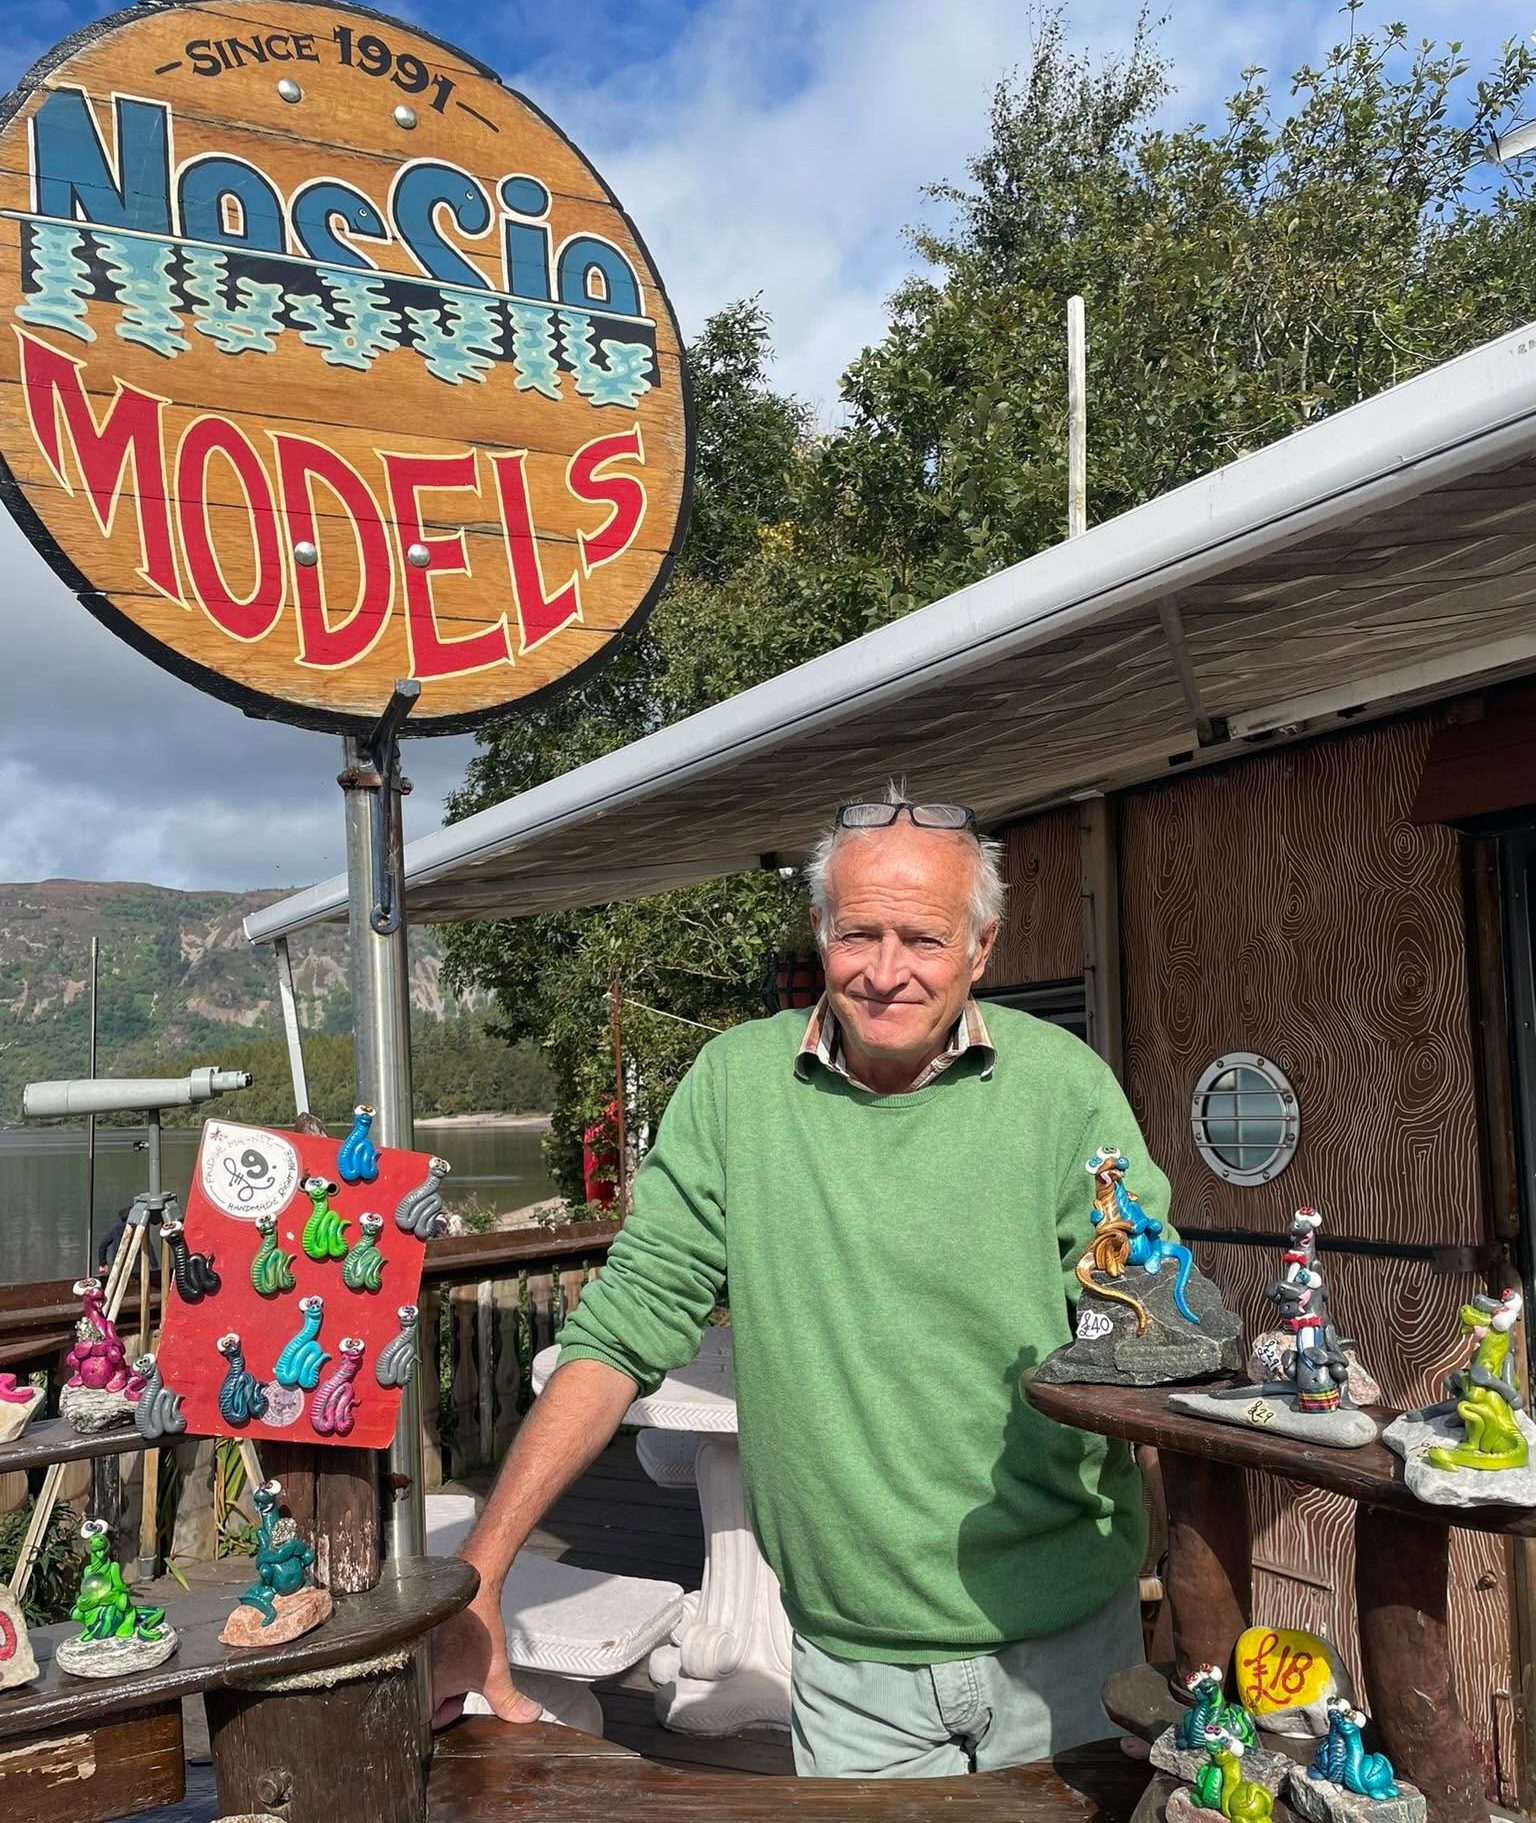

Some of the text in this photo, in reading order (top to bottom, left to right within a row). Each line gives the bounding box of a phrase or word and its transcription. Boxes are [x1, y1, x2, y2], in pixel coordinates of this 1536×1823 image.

[185, 25, 456, 113] SINCE 1991
[11, 323, 645, 681] MODELS
[227, 1197, 279, 1212] HANDMADE
[1079, 1312, 1110, 1337] £40
[1248, 1400, 1274, 1423] £29
[1243, 1632, 1313, 1707] £18
